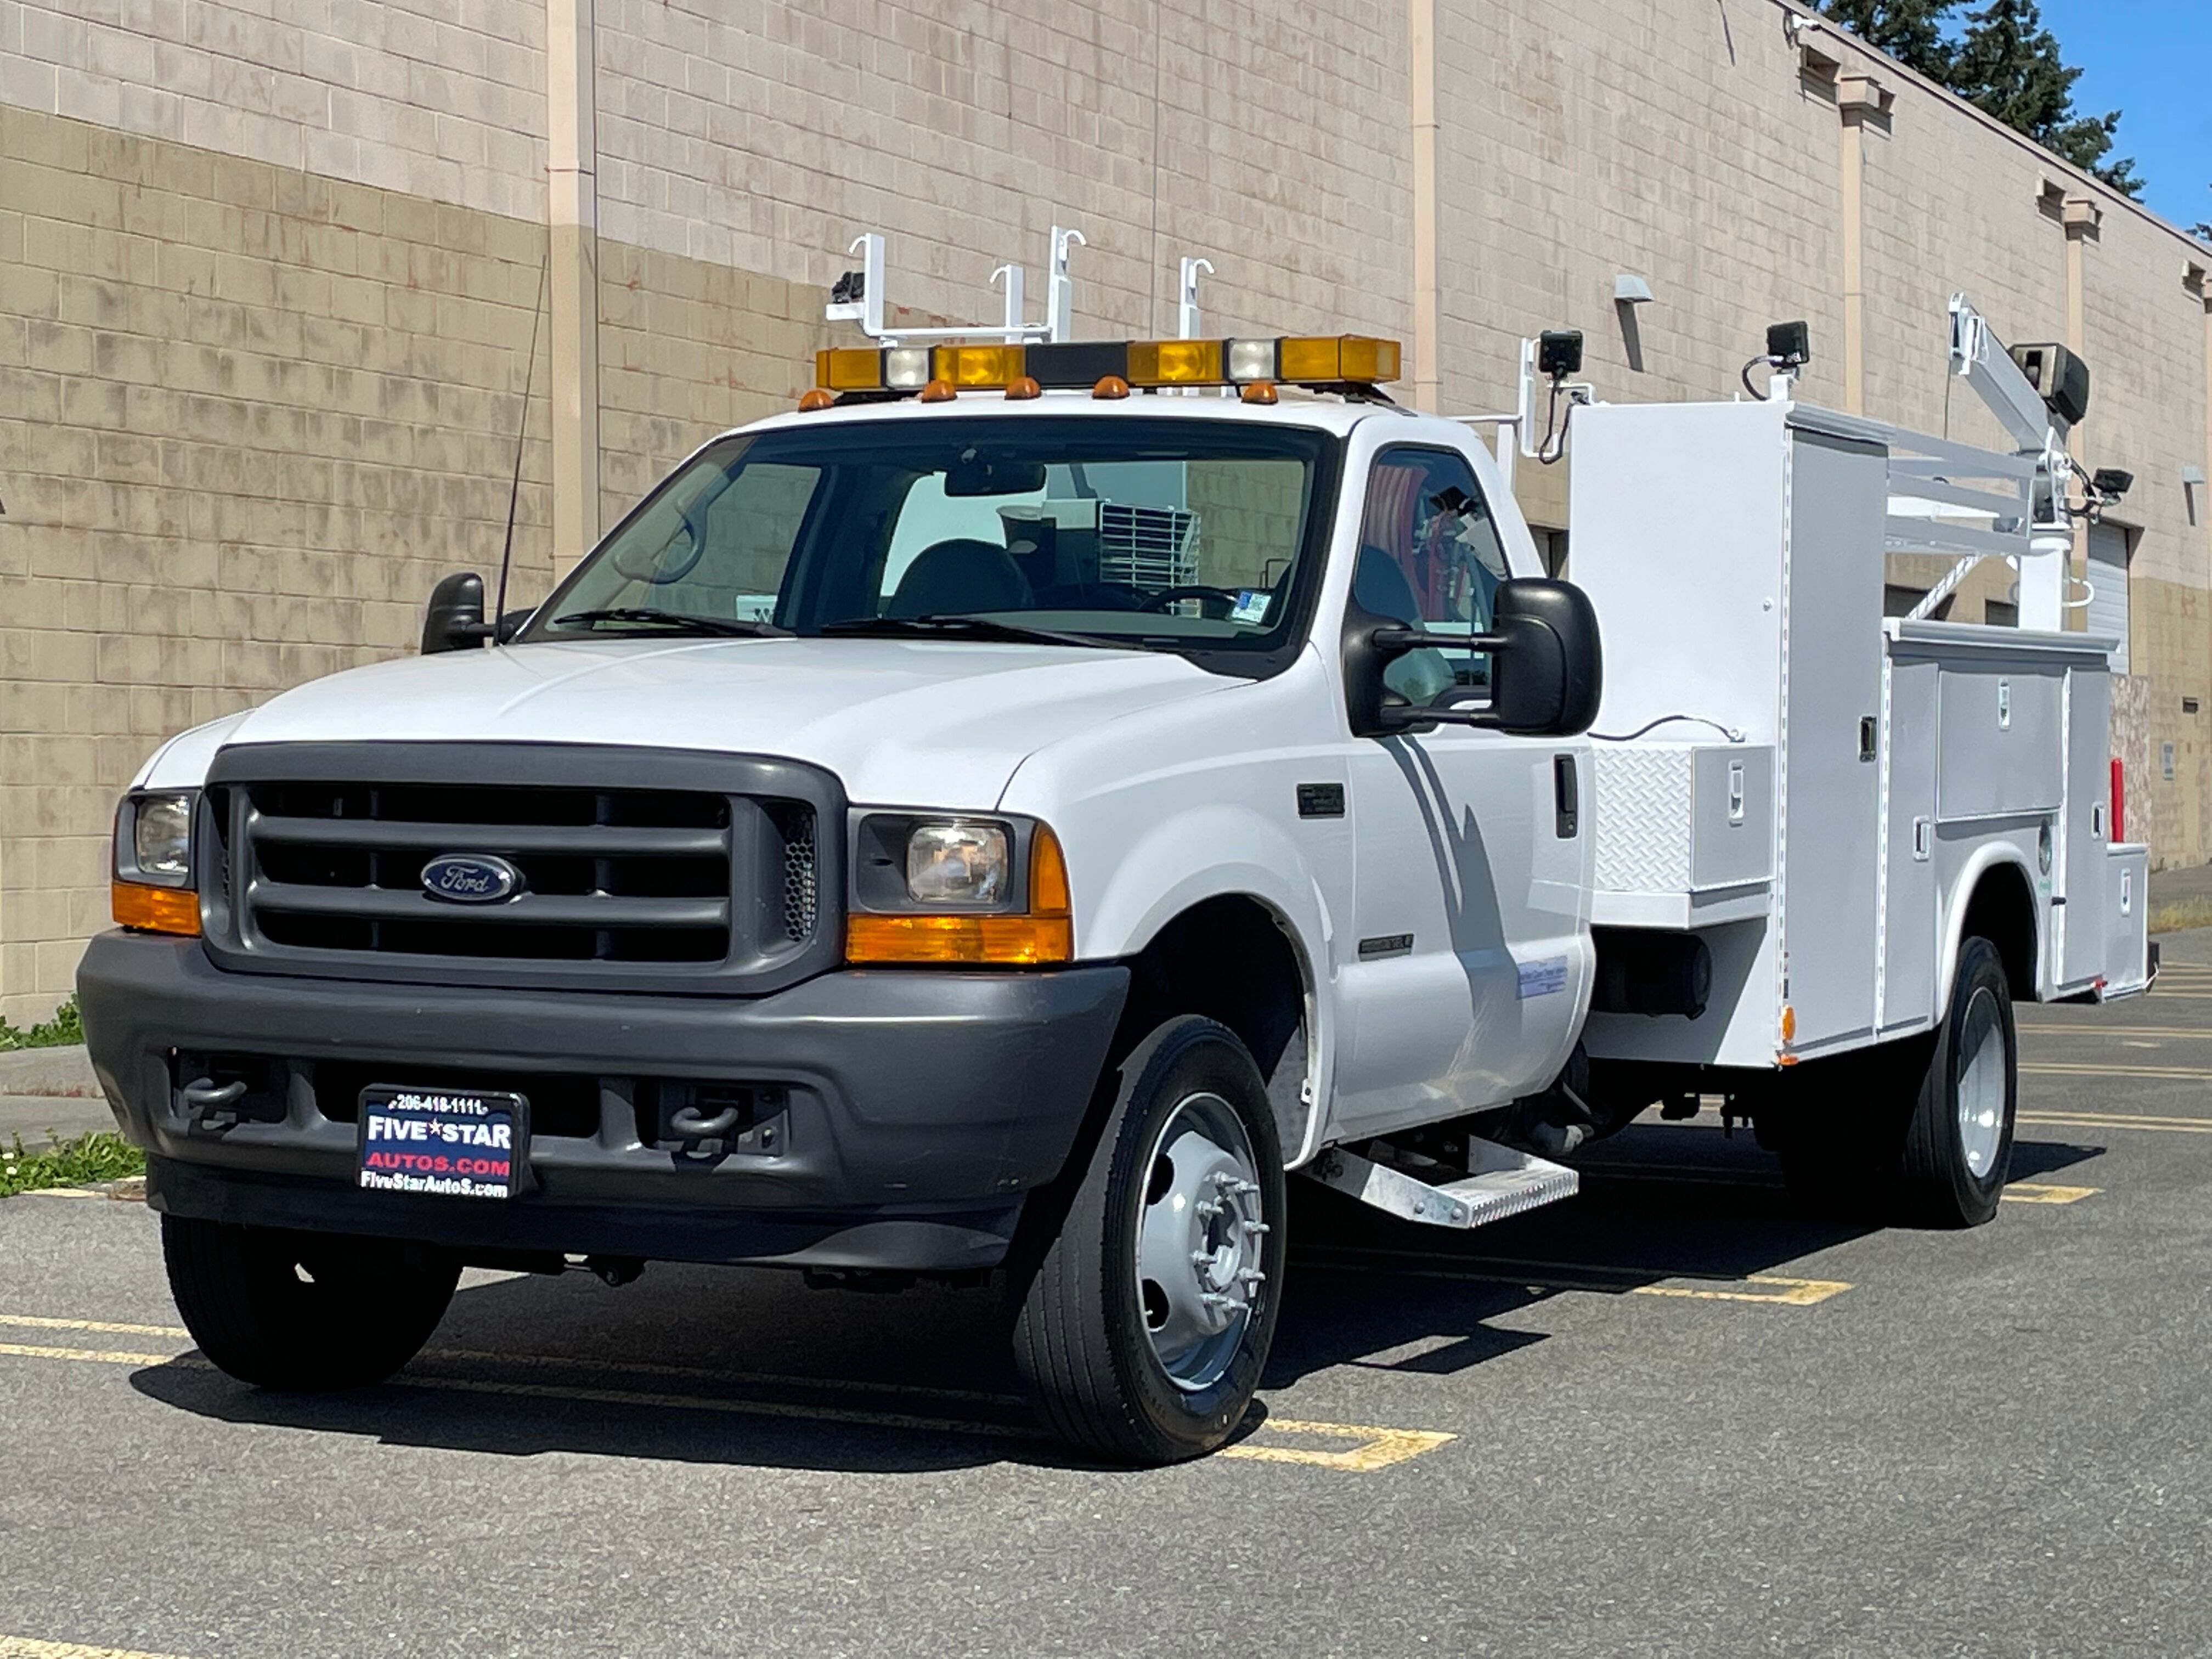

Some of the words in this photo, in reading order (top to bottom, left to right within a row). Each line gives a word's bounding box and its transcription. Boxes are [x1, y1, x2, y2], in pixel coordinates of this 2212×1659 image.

[441, 865, 489, 892] Ford
[368, 1115, 428, 1141] FIVE
[441, 1124, 511, 1149] STAR
[366, 1152, 510, 1176] AUTOS.COM
